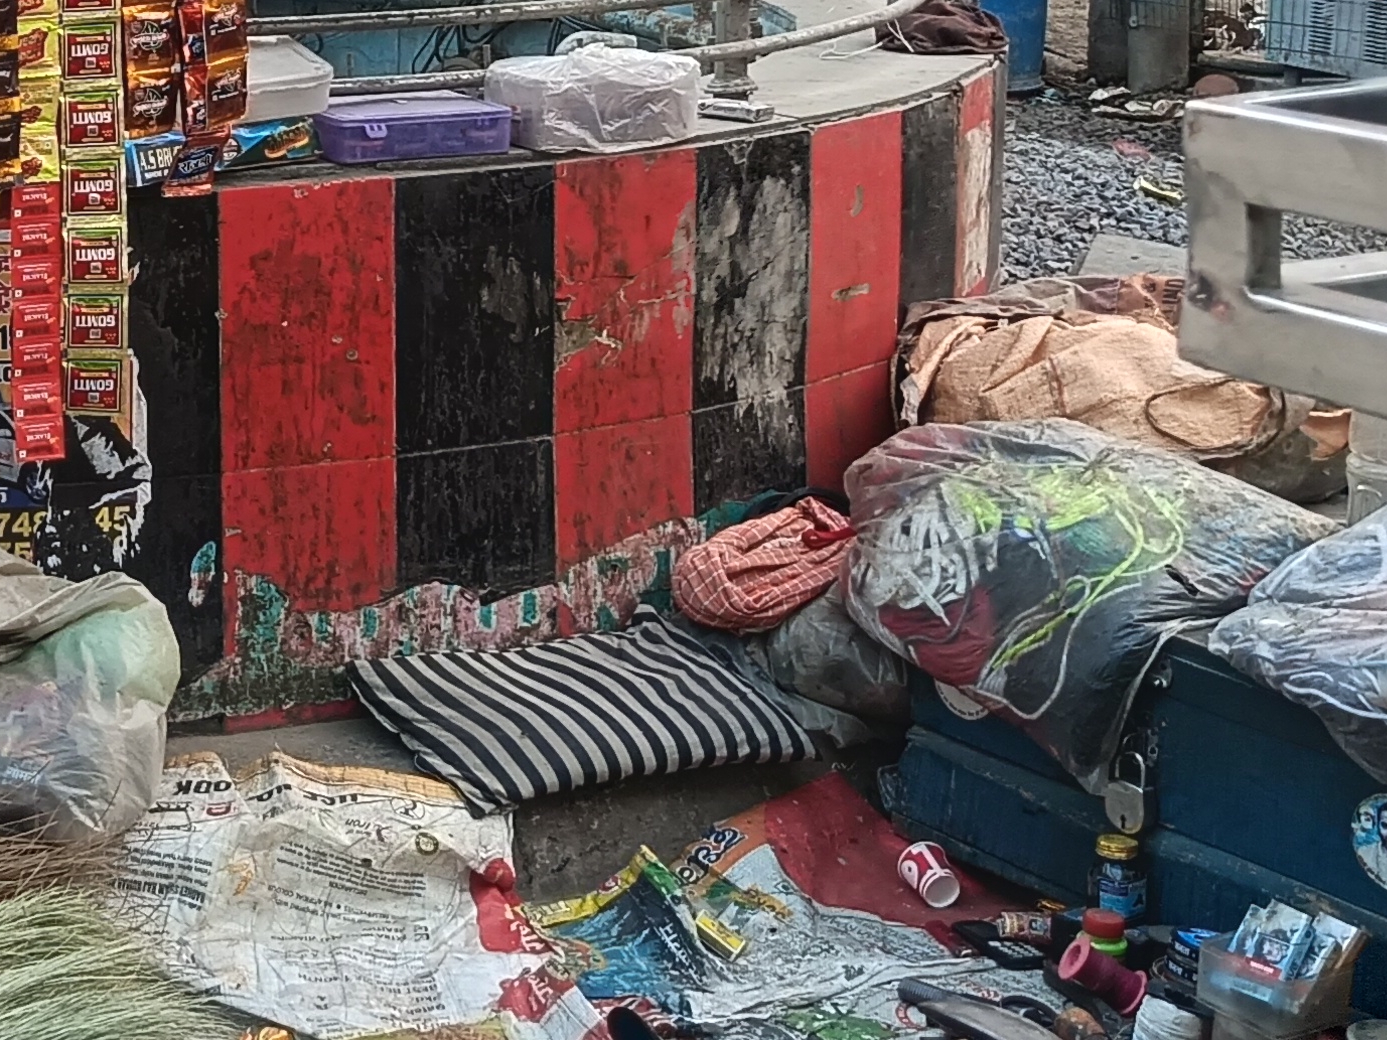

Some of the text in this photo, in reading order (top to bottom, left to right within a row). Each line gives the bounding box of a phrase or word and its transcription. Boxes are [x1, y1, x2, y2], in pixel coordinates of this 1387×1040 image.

[70, 42, 109, 57] GOMTI
[72, 110, 112, 125] GOMTI
[73, 178, 114, 193] GOMTI
[75, 247, 116, 262] GOMTI
[75, 314, 116, 328] GOMTI
[74, 377, 114, 391] GOMTI
